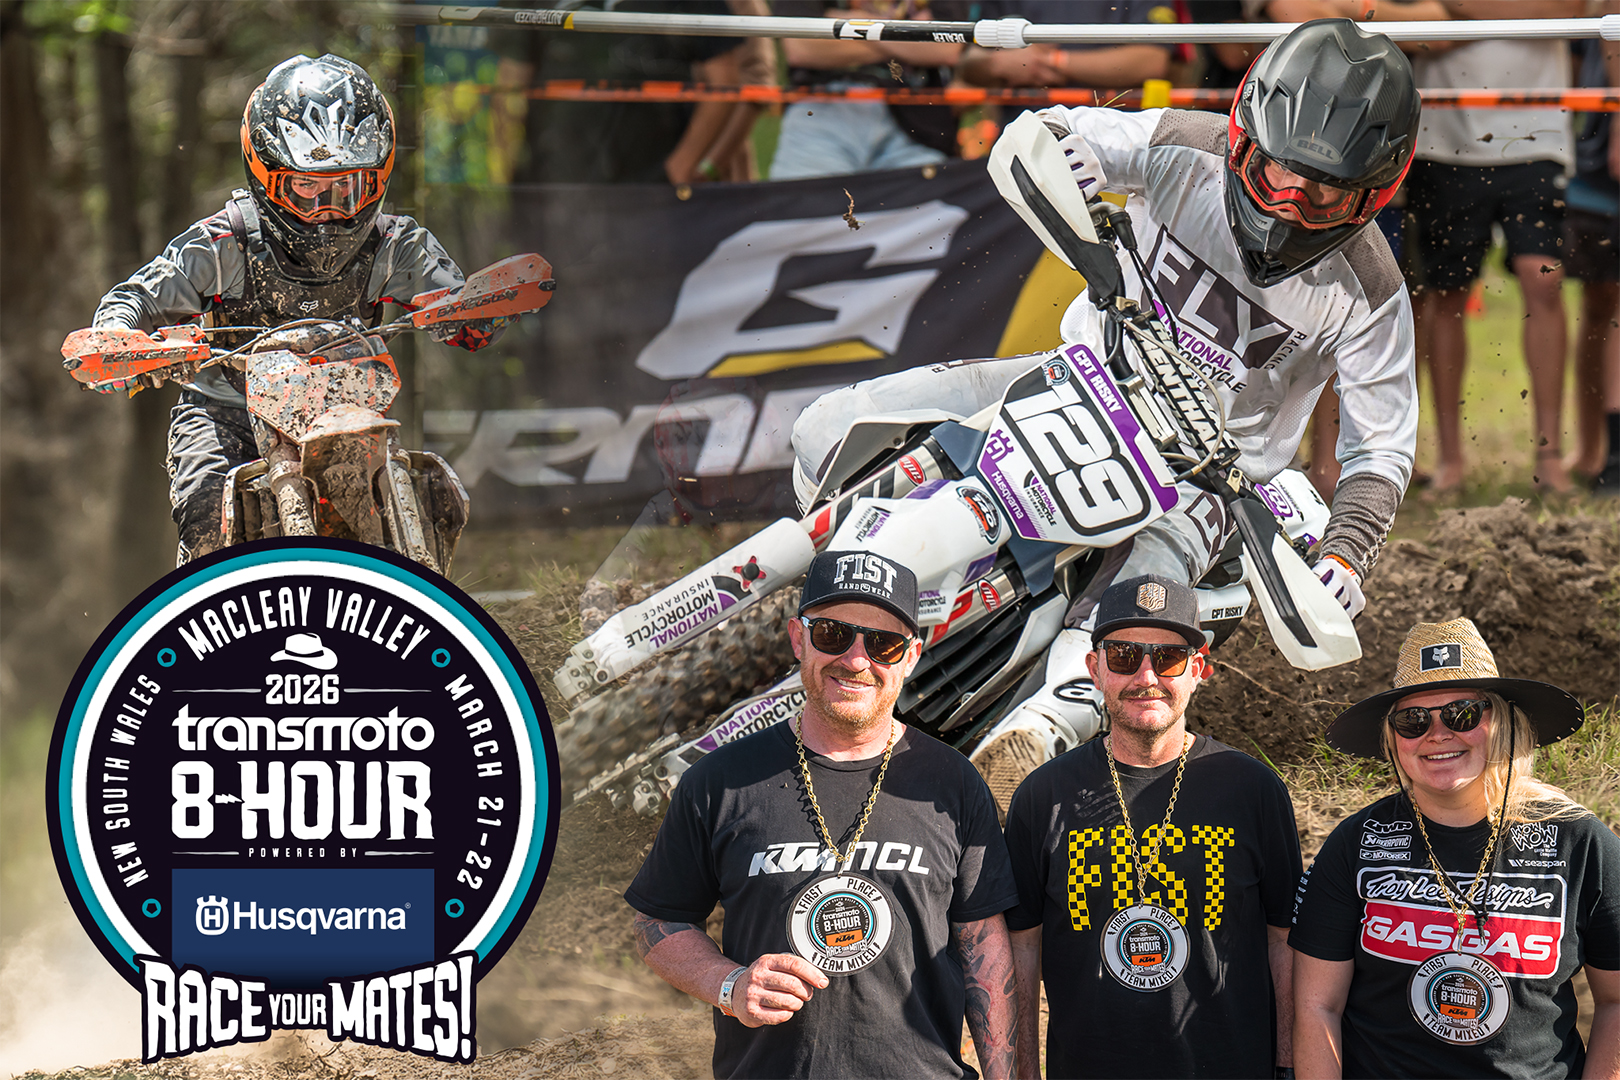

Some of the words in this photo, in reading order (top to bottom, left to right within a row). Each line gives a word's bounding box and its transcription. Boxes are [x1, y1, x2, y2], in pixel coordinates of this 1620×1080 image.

[932, 32, 966, 43] DEALER
[1295, 140, 1335, 160] BELL
[1150, 229, 1290, 359] FLY
[1263, 330, 1308, 371] RACING
[1072, 349, 1098, 376] CPT
[1089, 374, 1123, 413] RISKY
[1003, 380, 1145, 529] 129
[990, 470, 1025, 520] Husqvarna
[1030, 486, 1058, 527] MOTORCYCLE
[1035, 484, 1057, 515] NATIONAL
[833, 553, 898, 594] FIST
[642, 577, 710, 622] INSURANCE
[838, 582, 860, 590] HAND
[871, 587, 891, 599] WEAR
[623, 588, 716, 649] MOTORCYCLE
[1211, 608, 1224, 619] CPT
[1224, 605, 1243, 618] RISKY
[649, 602, 719, 649] NATIONAL
[1372, 851, 1408, 860] MOTOREX
[1525, 860, 1567, 868] seaspan
[1067, 823, 1235, 931] FIST
[1366, 872, 1414, 901] Troy
[1409, 875, 1455, 902] Lee
[798, 884, 823, 909] FIRST
[846, 878, 877, 899] PLACE
[821, 908, 860, 921] transmoto
[823, 915, 862, 932] 8-HOUR
[1110, 910, 1131, 932] FIRST
[1150, 907, 1176, 928] PLACE
[834, 933, 855, 943] KTM
[1130, 941, 1161, 953] 8-HOUR
[1366, 915, 1554, 961] GASGAS
[816, 955, 843, 971] TEAM
[846, 947, 877, 971] MIXED
[1422, 956, 1448, 975] FIRST
[1471, 959, 1500, 983] PLACE
[1123, 972, 1146, 988] TEAM
[1148, 970, 1174, 988] MIXED
[1441, 984, 1479, 996] transmoto
[1440, 991, 1477, 1007] 8-HOUR
[1447, 1008, 1468, 1016] KTM
[1427, 1017, 1452, 1038] TEAM
[1454, 1028, 1486, 1040] MIXED
